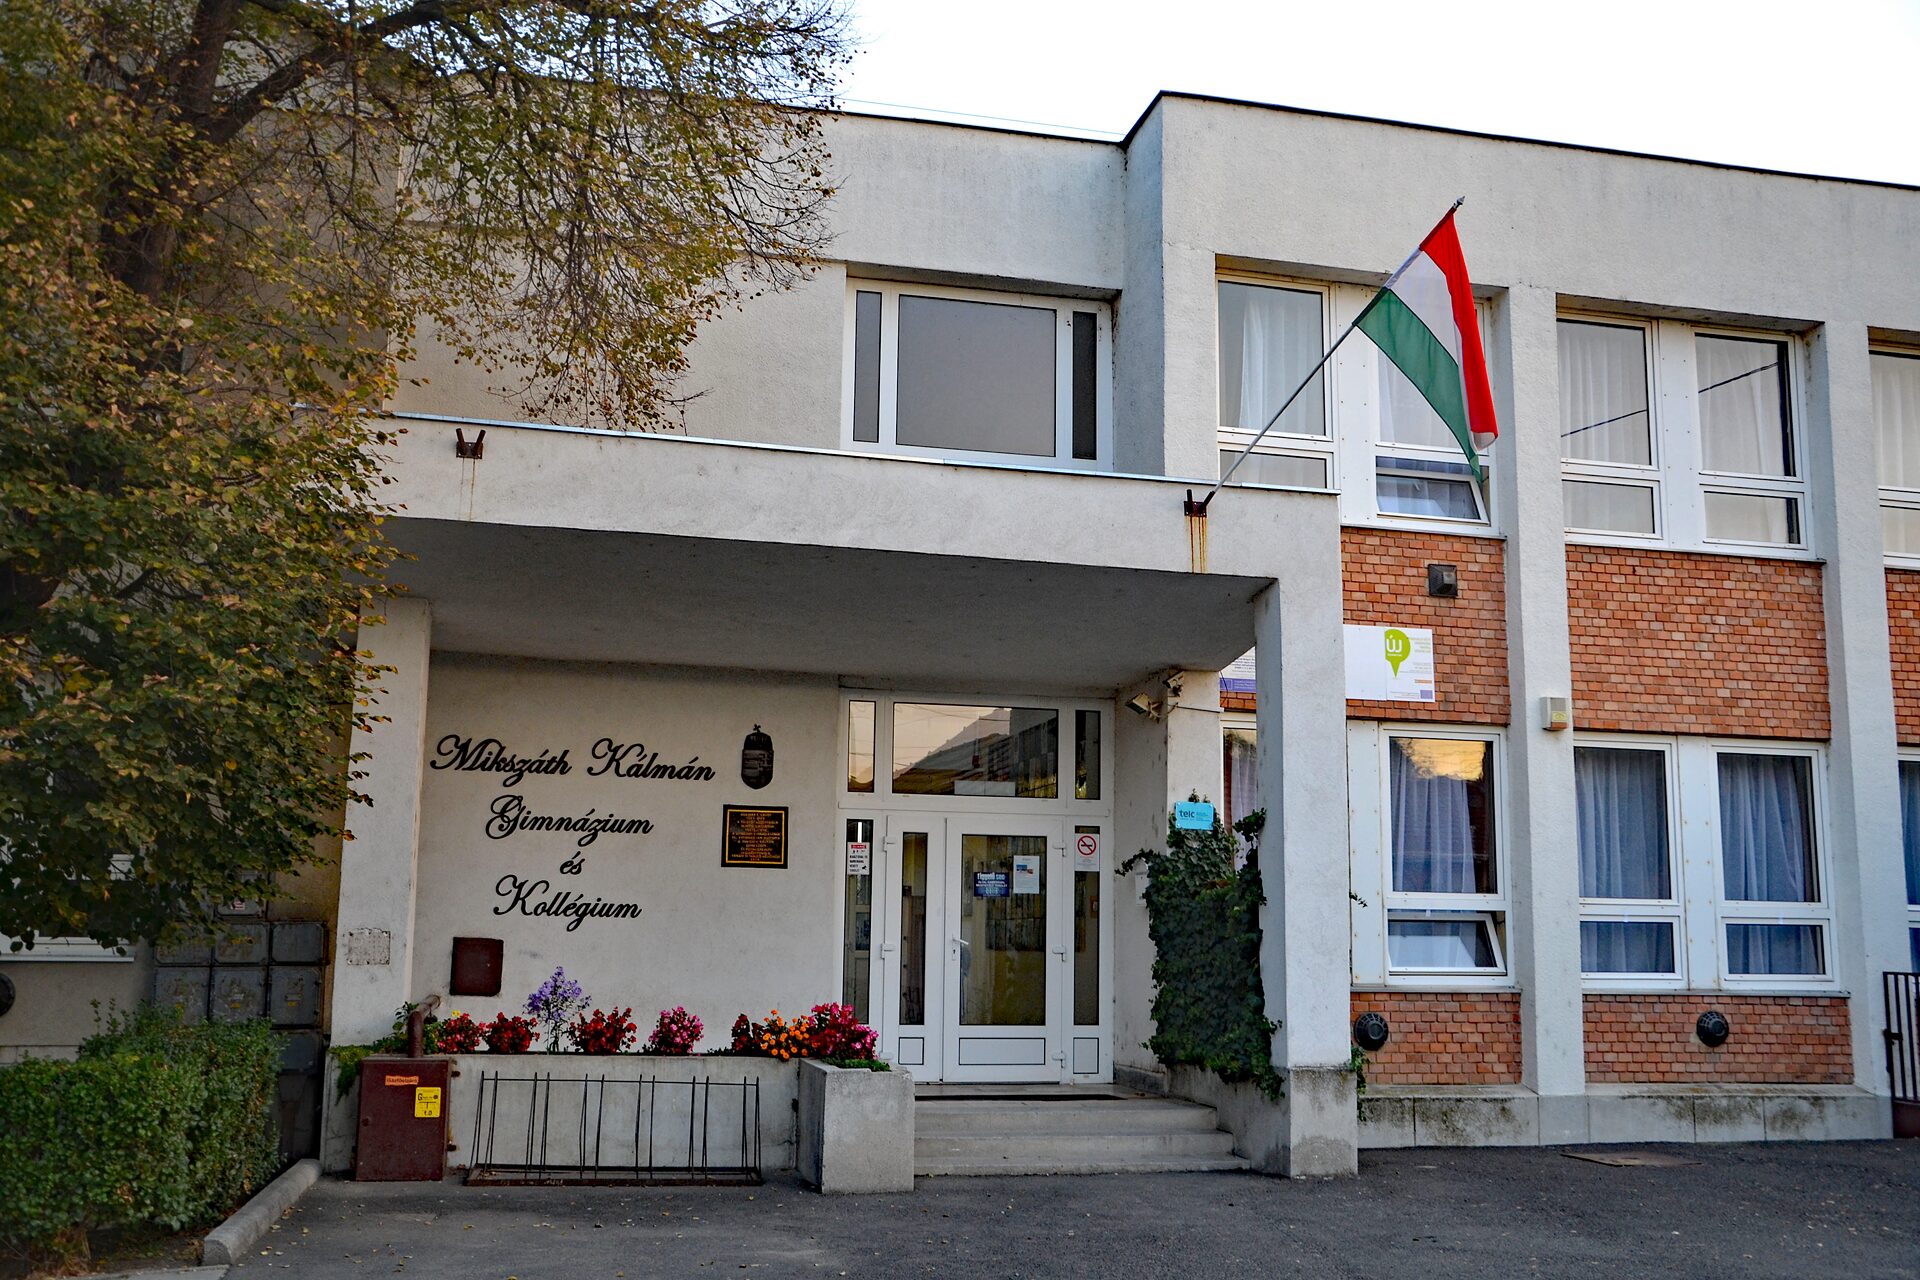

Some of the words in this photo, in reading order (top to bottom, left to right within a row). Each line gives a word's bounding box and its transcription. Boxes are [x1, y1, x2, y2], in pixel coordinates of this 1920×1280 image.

[430, 734, 572, 787] Mikszáth
[587, 738, 715, 781] Kálmán
[485, 795, 654, 847] Gimnázium
[1179, 809, 1195, 818] telc
[559, 851, 584, 875] és
[493, 874, 642, 932] Kollégium
